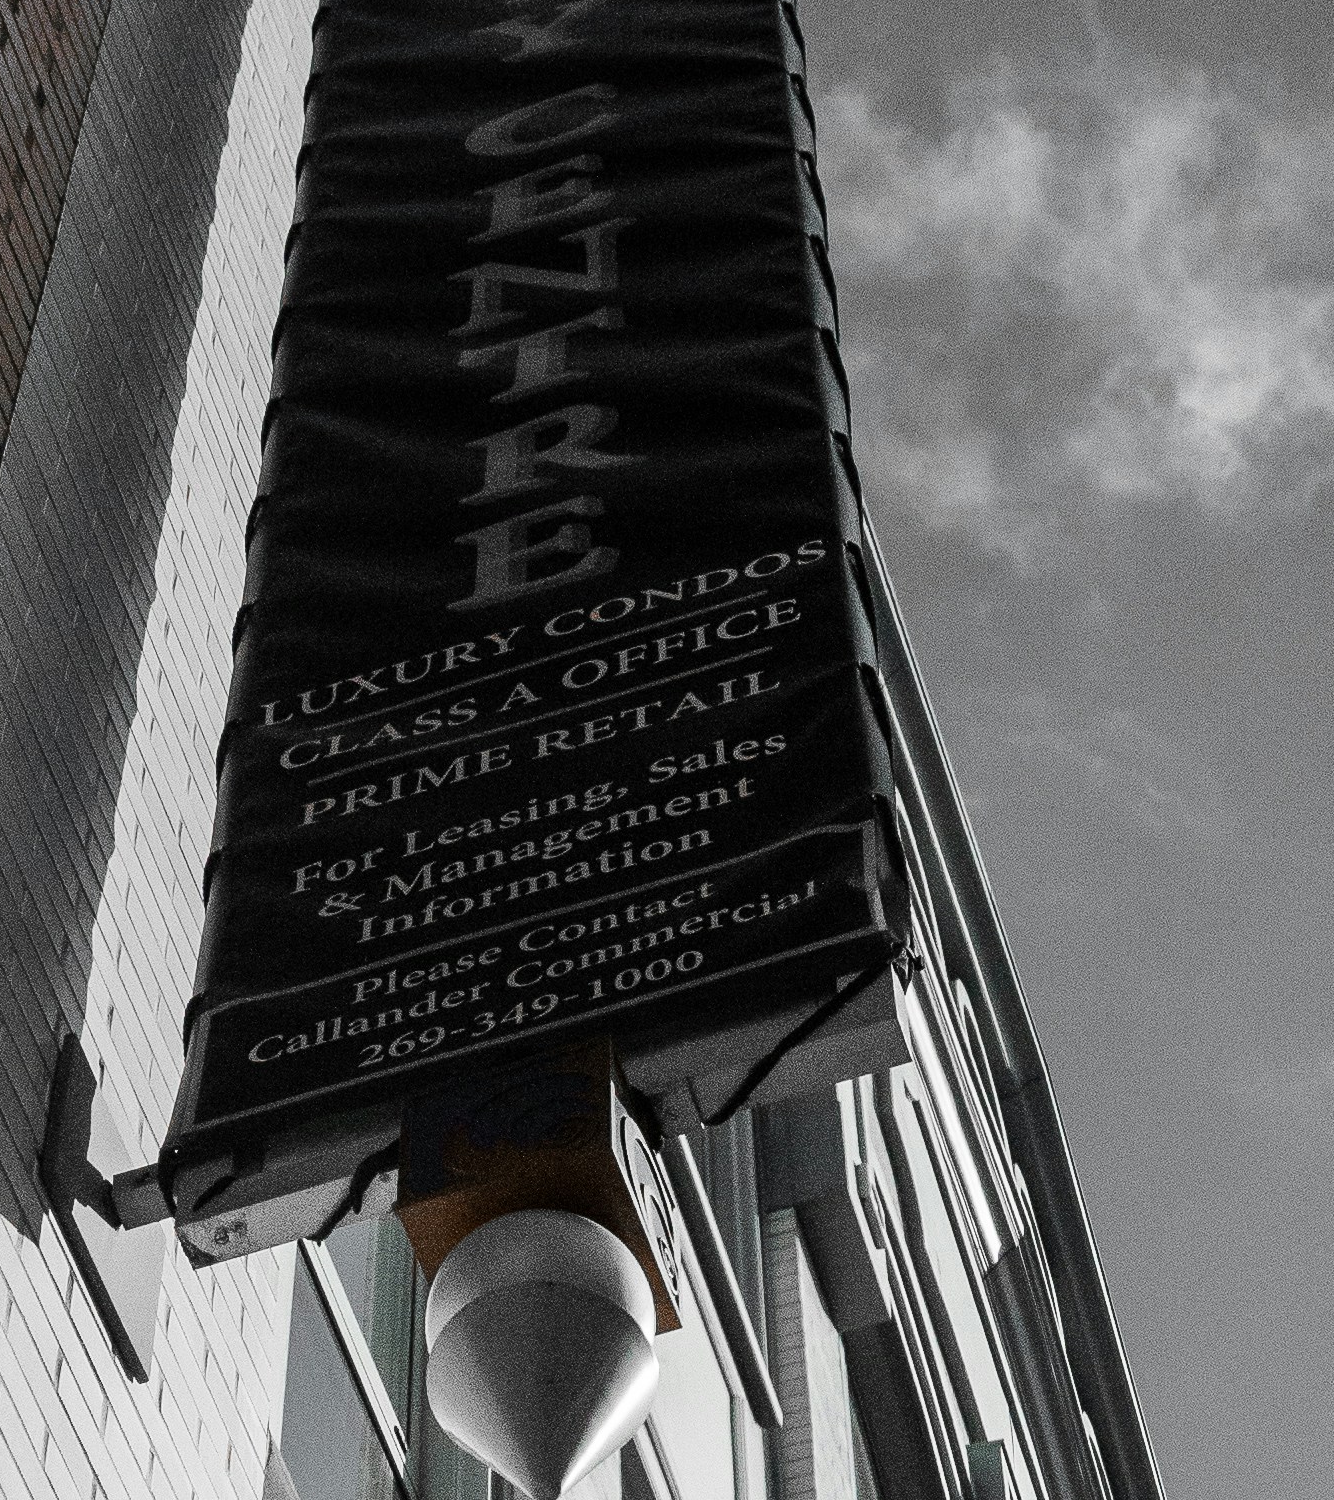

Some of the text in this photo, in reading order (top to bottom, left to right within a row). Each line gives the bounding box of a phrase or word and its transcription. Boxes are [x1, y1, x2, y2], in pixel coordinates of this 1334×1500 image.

[447, 82, 646, 612] CENTRE
[260, 538, 827, 726] LUXURY CONDOS
[279, 597, 803, 770] CLASS A OFFICE
[291, 730, 787, 894] For Leasing, Sales
[298, 670, 780, 826] PRIME RETAIL
[317, 774, 756, 918] & Management
[356, 828, 713, 944] Information
[248, 879, 819, 1065] Callander Commercial
[350, 879, 715, 1005] Please Contact
[356, 948, 705, 1069] 269-349-1000
